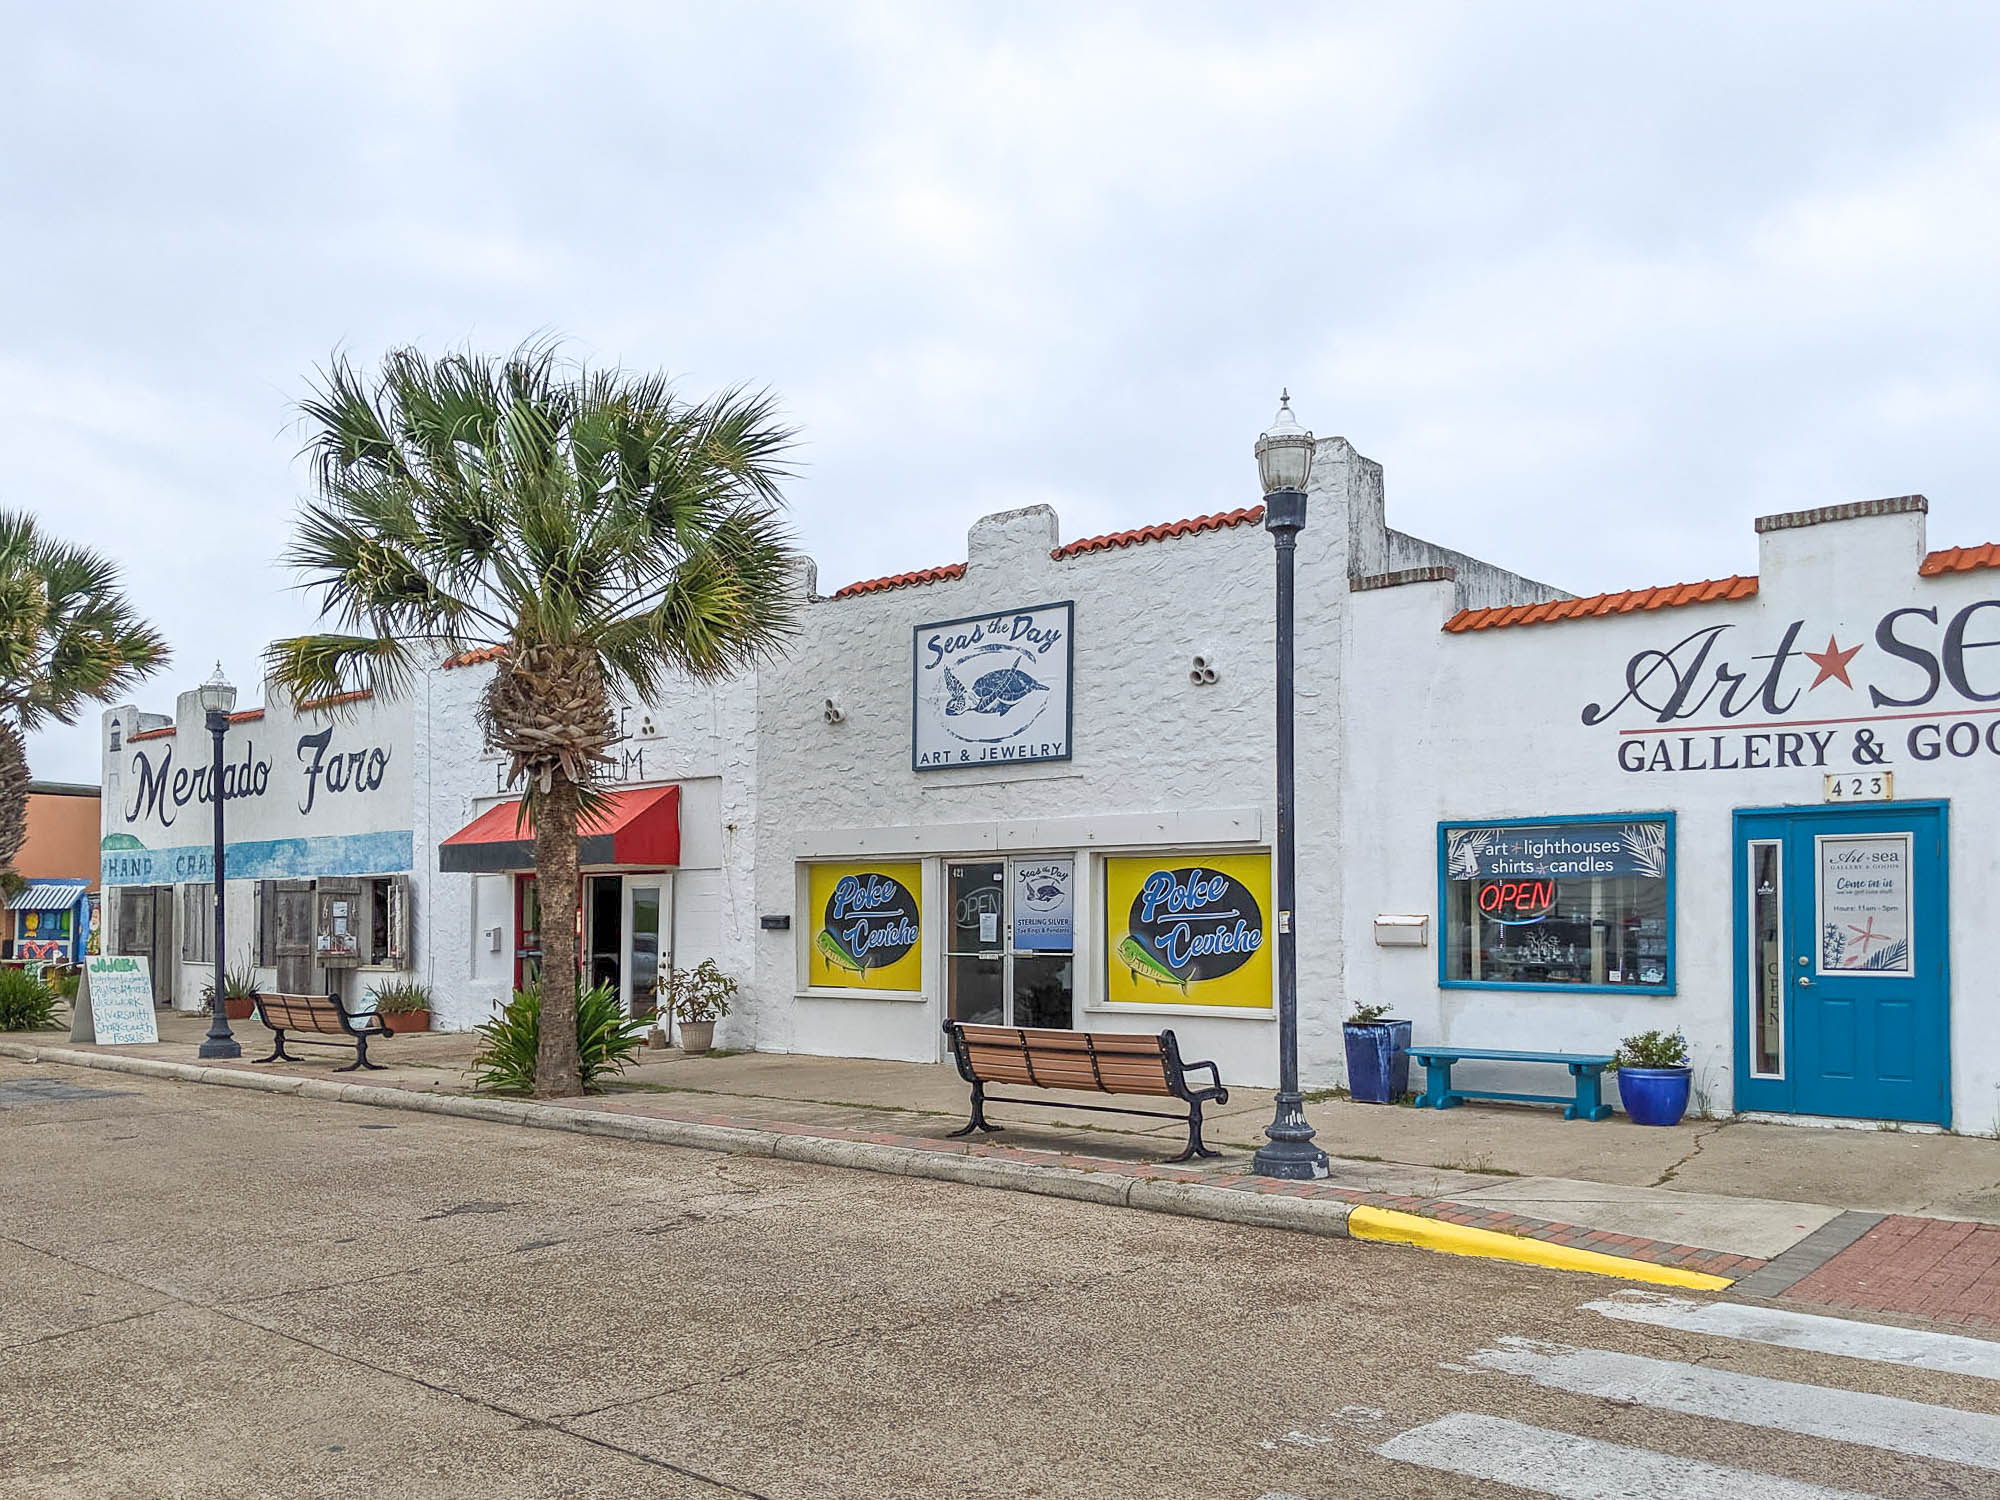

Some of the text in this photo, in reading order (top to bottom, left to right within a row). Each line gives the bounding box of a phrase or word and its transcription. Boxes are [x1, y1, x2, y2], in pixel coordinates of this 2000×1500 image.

[925, 615, 1062, 670] Seas the Day
[1581, 619, 1805, 726] Art
[920, 742, 1063, 764] ART & JEWELRY
[1617, 730, 1838, 773] GALLERY
[1852, 728, 1894, 765] &
[296, 725, 392, 816] Faro
[1831, 777, 1882, 796] 423
[1485, 839, 1621, 859] art lighthouses
[1871, 852, 1899, 862] sea
[108, 858, 152, 877] HAND
[1491, 859, 1614, 874] shirts candles
[833, 875, 897, 919] Poke
[1141, 869, 1229, 923] Poke
[1479, 882, 1553, 912] OPEN
[1837, 877, 1866, 890] Come
[955, 892, 1001, 922] OPEN
[843, 917, 919, 958] Ceviche
[1017, 918, 1069, 927] STERLING SILVER
[1154, 919, 1262, 968] Ceviche
